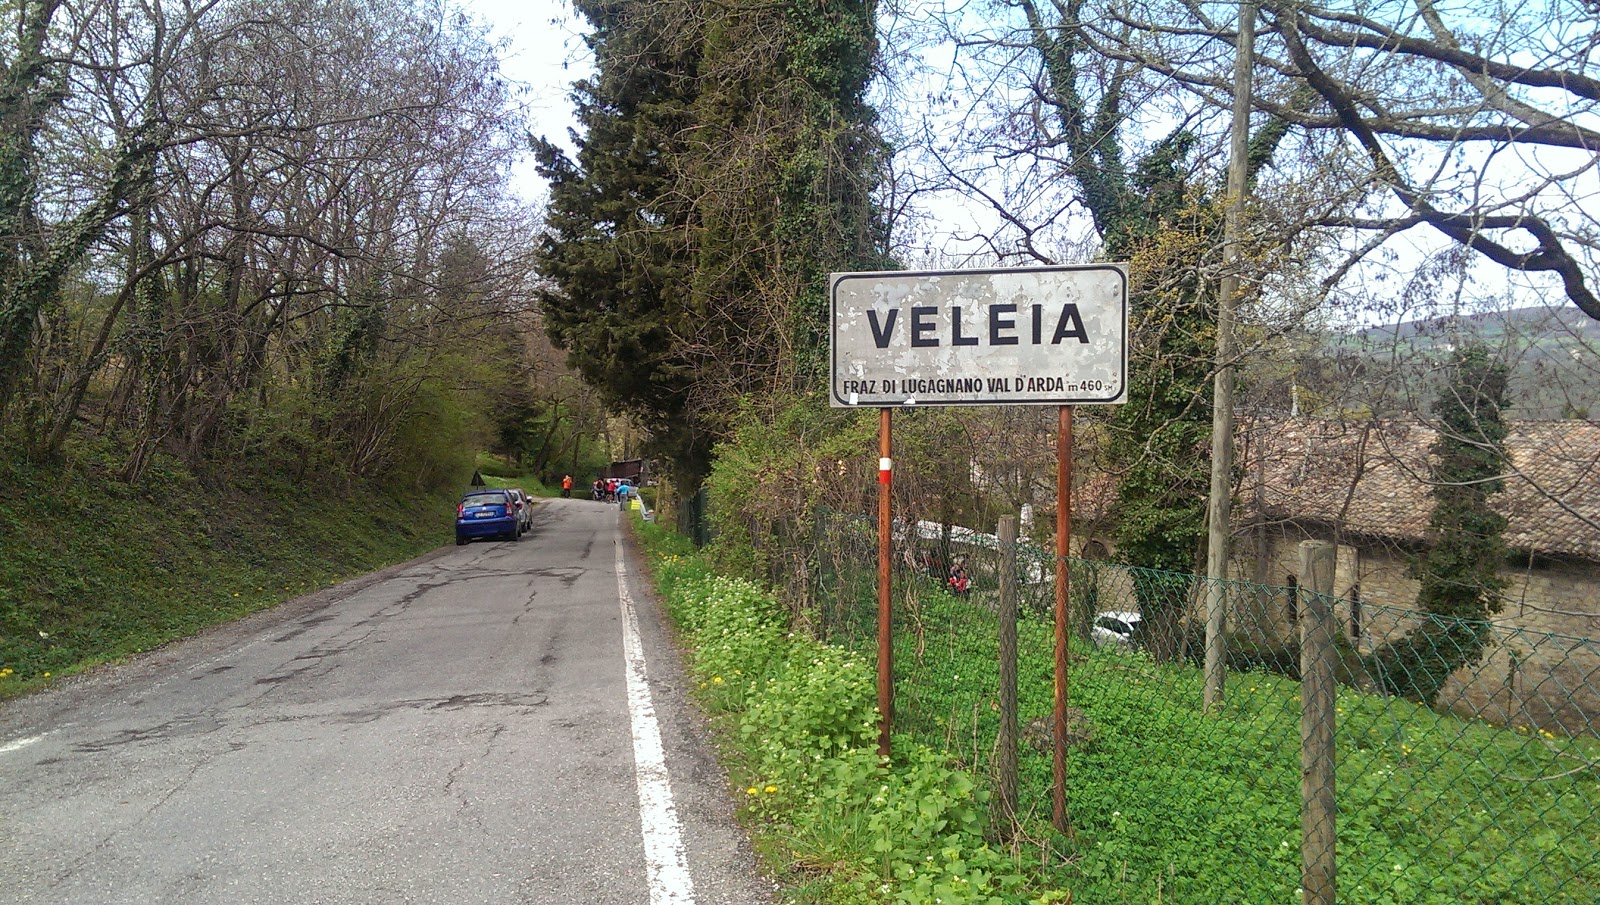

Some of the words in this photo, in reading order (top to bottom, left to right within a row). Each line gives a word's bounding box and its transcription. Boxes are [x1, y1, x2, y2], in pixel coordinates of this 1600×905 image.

[866, 303, 1090, 348] VELEIA
[843, 380, 876, 394] FRAZ
[882, 379, 896, 394] DI
[902, 378, 983, 394] LUGAGNANO
[987, 378, 1011, 393] VAL
